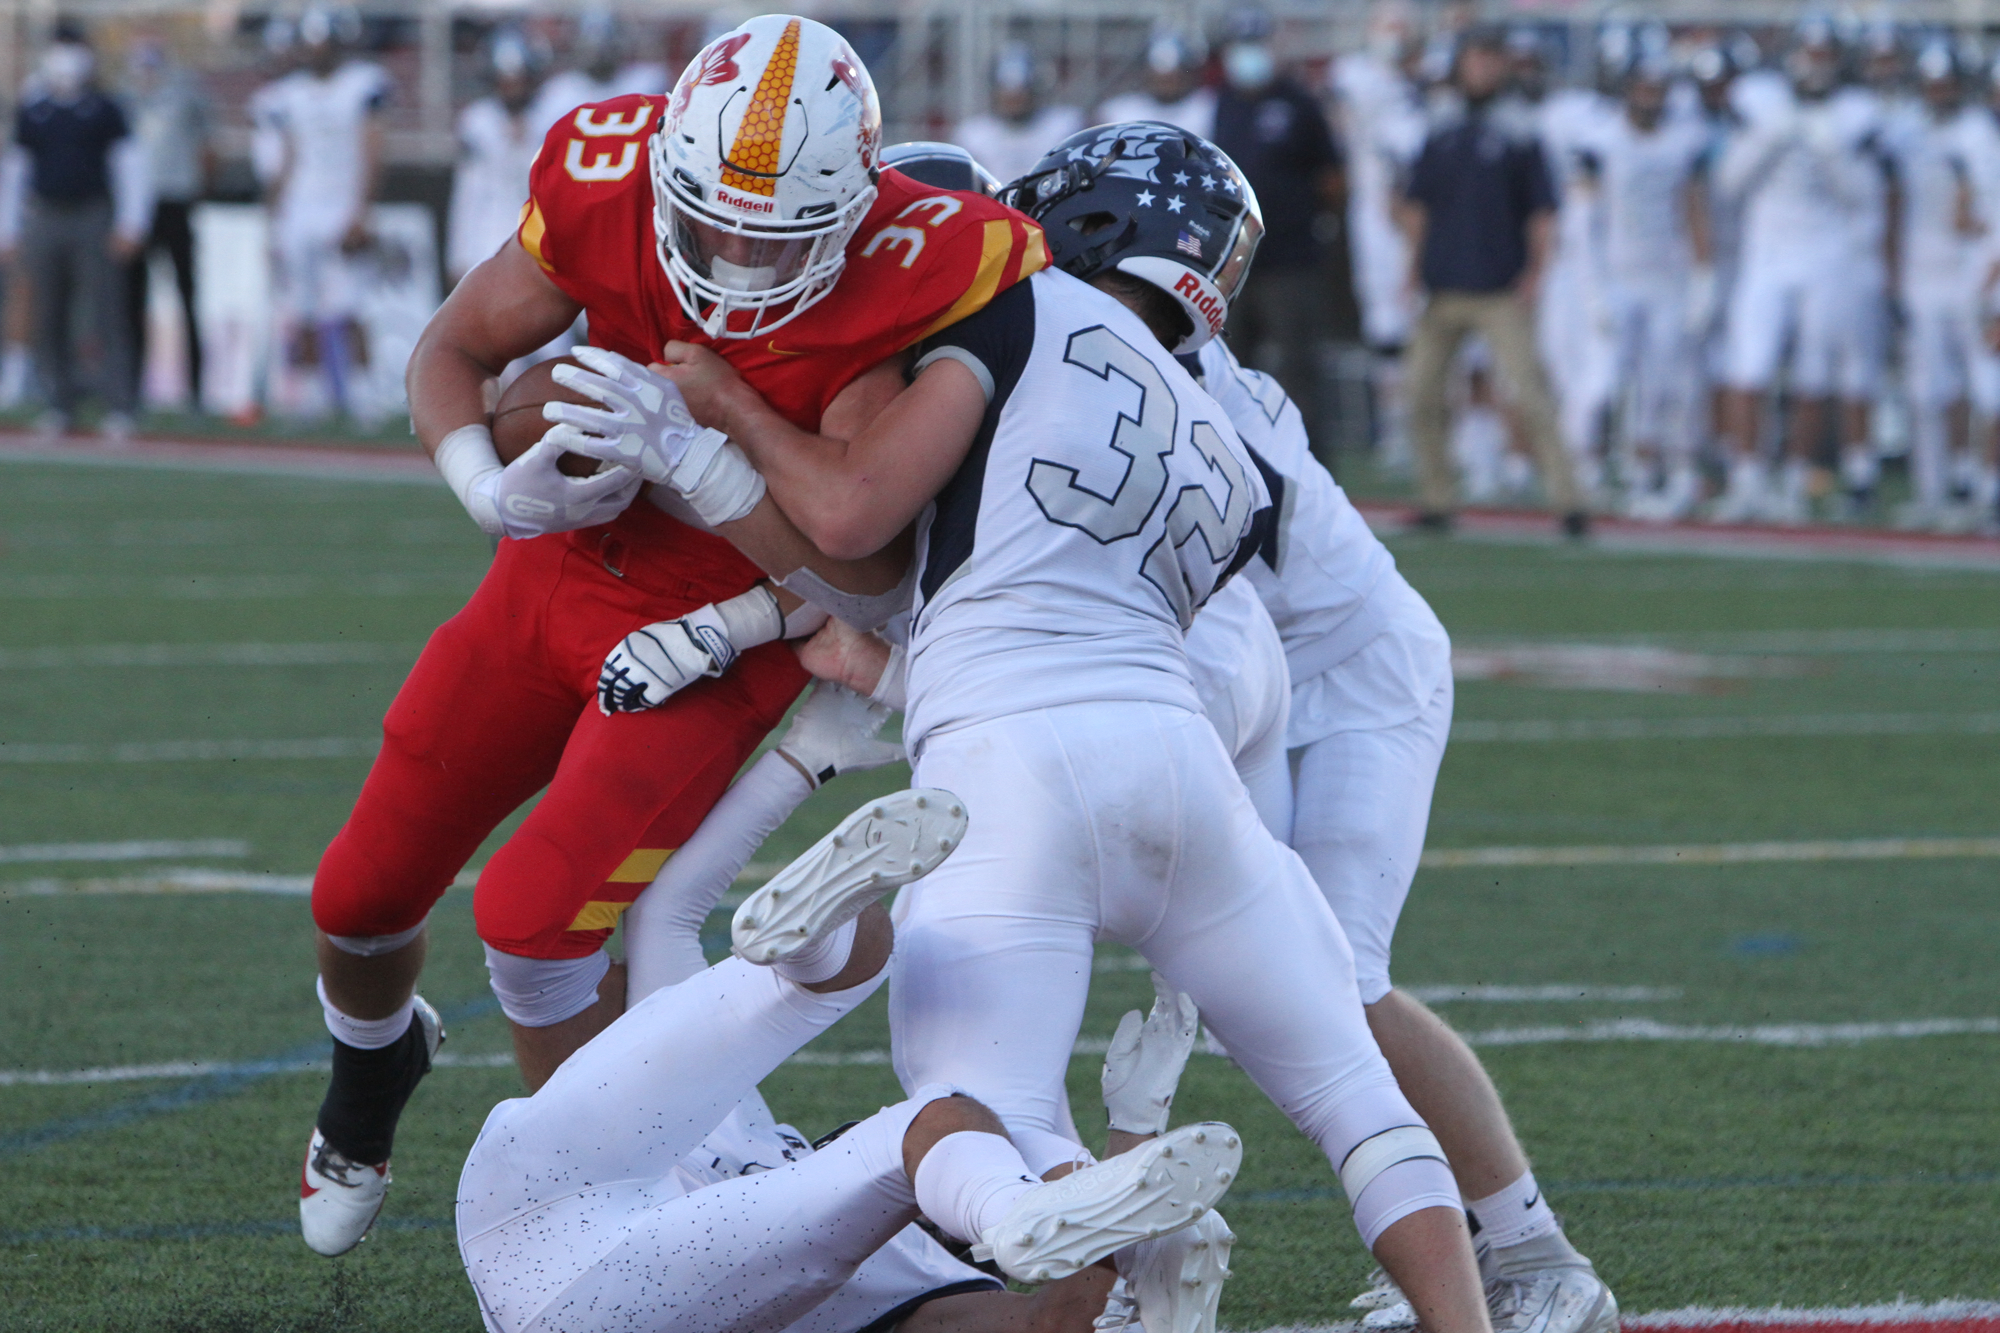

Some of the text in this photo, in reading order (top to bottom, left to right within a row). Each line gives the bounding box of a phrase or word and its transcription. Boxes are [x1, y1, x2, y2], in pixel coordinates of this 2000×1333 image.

[564, 104, 655, 182] 33
[717, 190, 774, 213] Riddell
[861, 195, 963, 269] 33
[1025, 323, 1252, 632] 32
